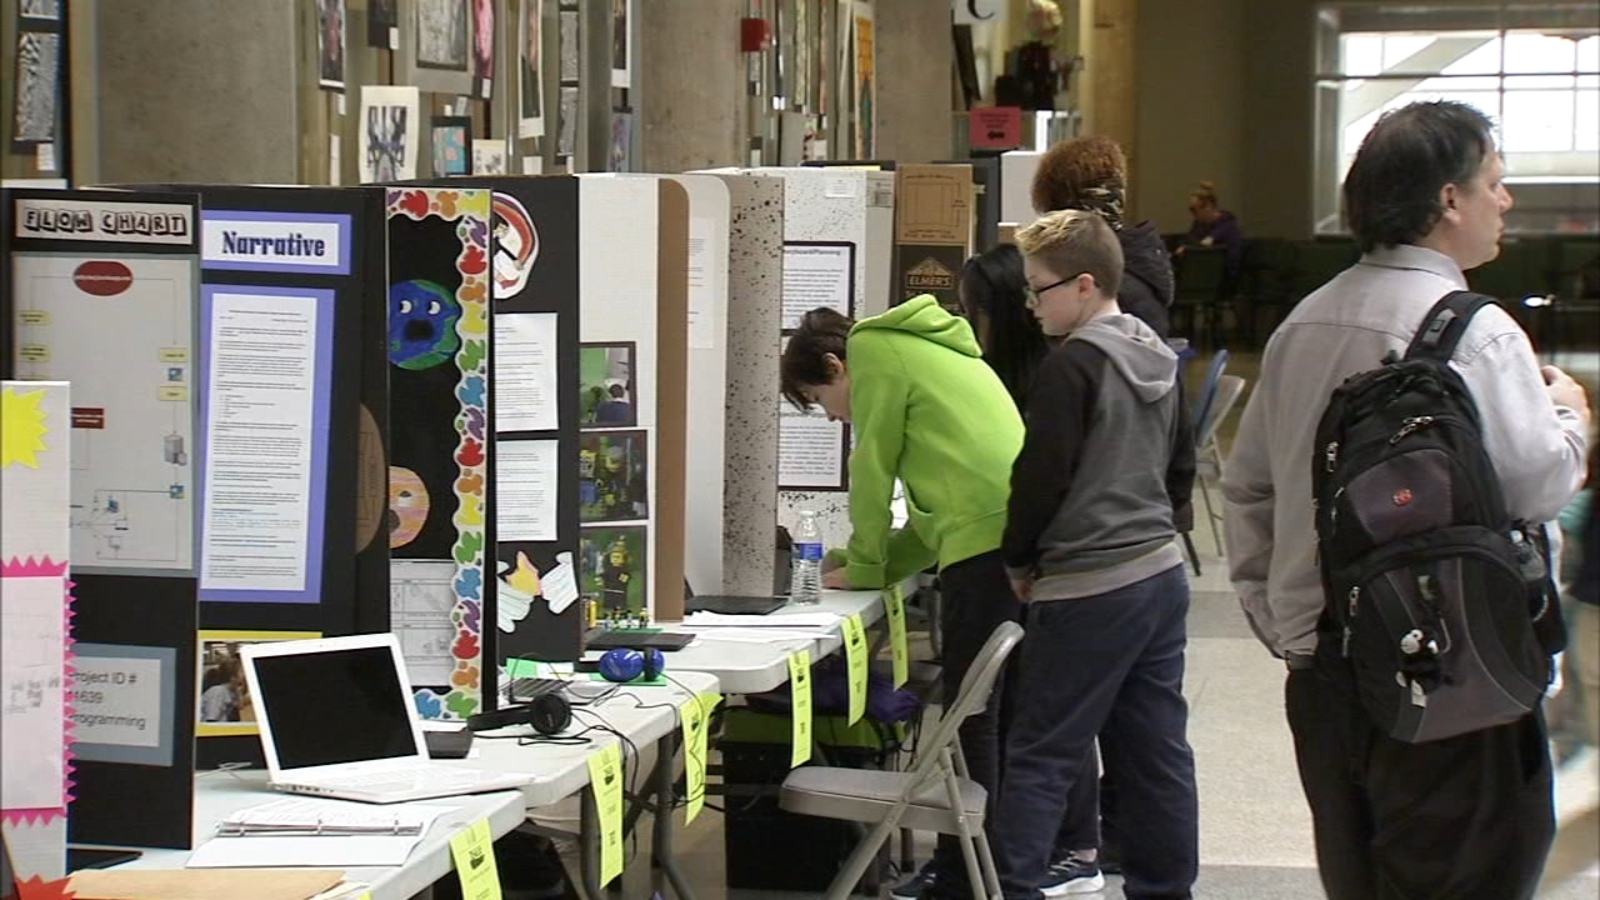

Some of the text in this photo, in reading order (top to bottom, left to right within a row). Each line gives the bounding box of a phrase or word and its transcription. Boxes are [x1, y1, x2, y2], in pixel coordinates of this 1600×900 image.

[24, 208, 187, 236] FLOW CHART
[223, 231, 325, 257] Narrative
[68, 671, 108, 685] roject
[112, 672, 126, 684] ID
[68, 714, 146, 730] rogramming
